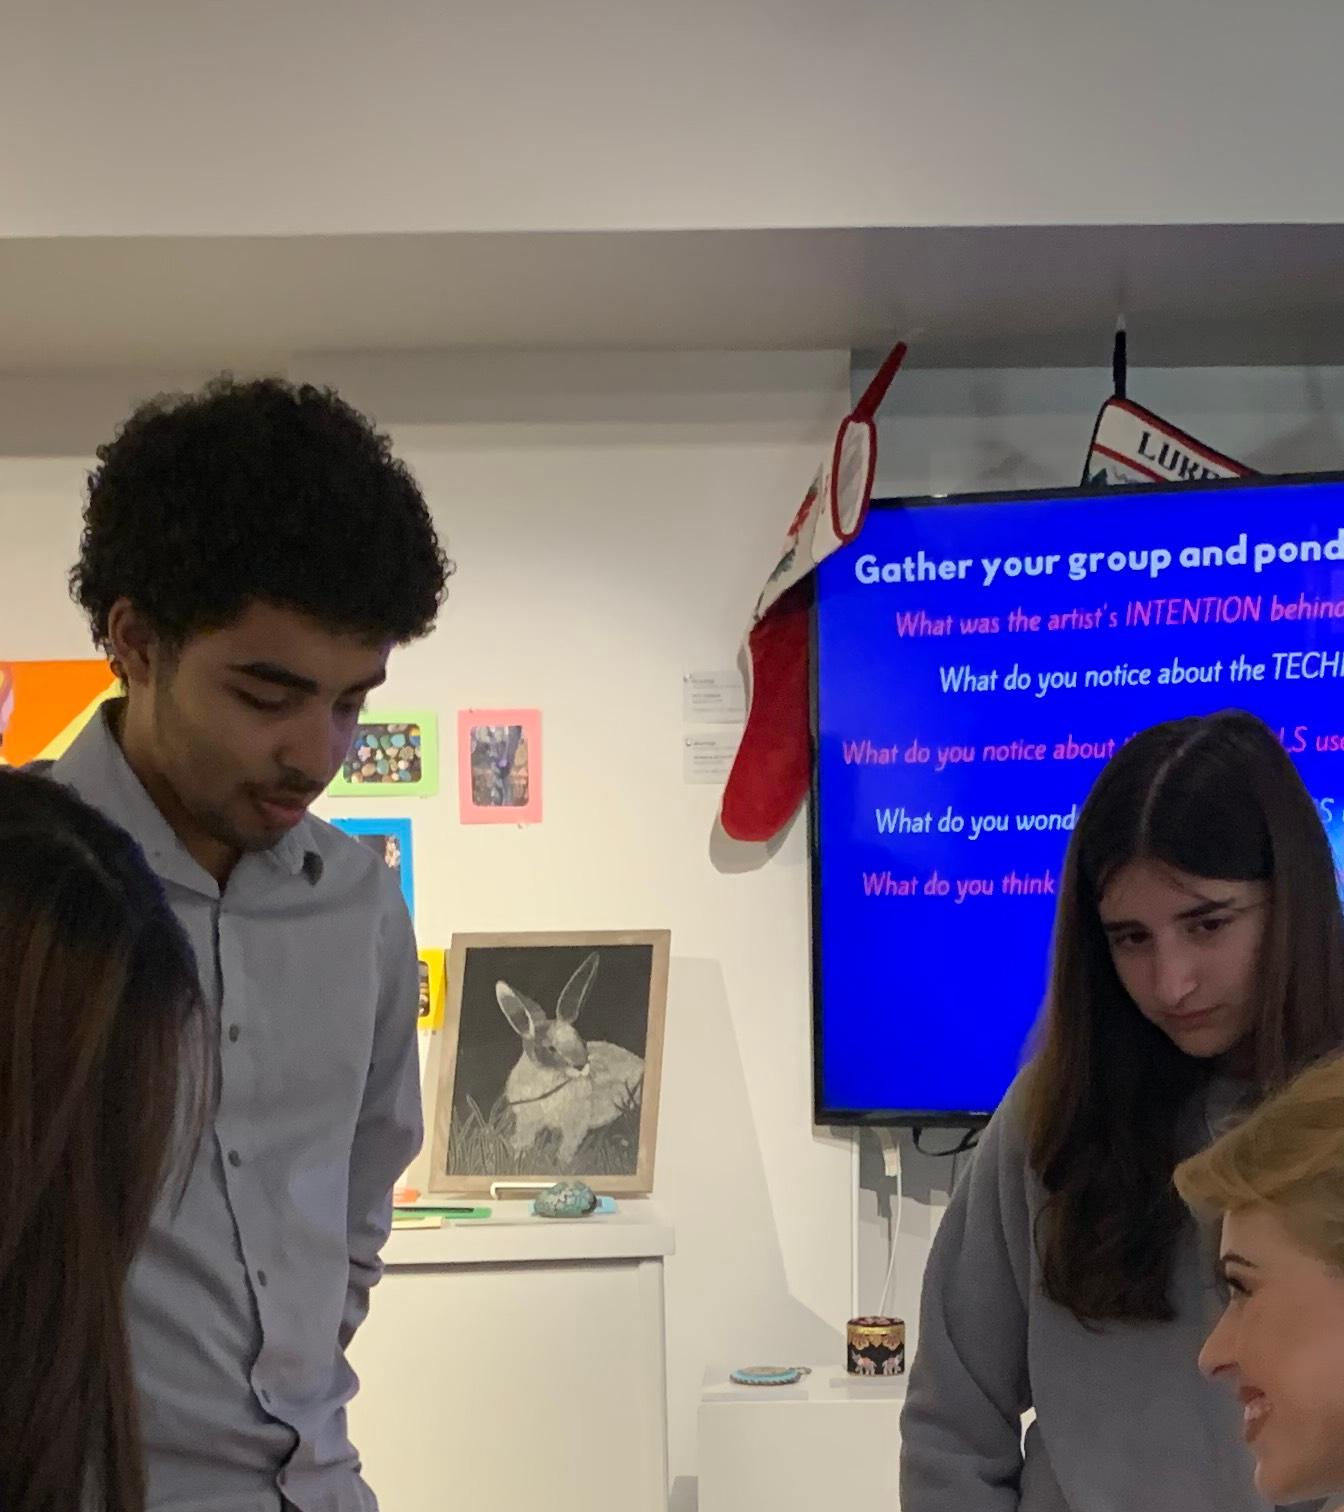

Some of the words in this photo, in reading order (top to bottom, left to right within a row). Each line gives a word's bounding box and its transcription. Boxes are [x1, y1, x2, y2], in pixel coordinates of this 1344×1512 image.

[855, 550, 973, 584] Gather
[981, 554, 1061, 587] your
[1068, 547, 1171, 581] group
[1179, 533, 1247, 568] and
[895, 611, 953, 638] What
[959, 615, 1000, 635] was
[1008, 606, 1041, 633] the
[1047, 602, 1118, 631] artist's
[1125, 595, 1262, 627] INTENTION
[939, 664, 998, 694] What
[1003, 663, 1032, 690] do
[1035, 671, 1077, 699] you
[1084, 663, 1152, 688] notice
[1157, 656, 1222, 684] about
[1229, 654, 1265, 681] the
[842, 739, 898, 765] What
[904, 738, 930, 763] do
[937, 745, 975, 772] you
[982, 738, 1046, 763] notice
[1052, 734, 1115, 761] about
[875, 807, 933, 835] What
[937, 806, 965, 833] do
[969, 814, 1009, 841] you
[1015, 804, 1078, 831] wond
[862, 871, 919, 897] What
[923, 870, 950, 896] do
[954, 878, 994, 905] you
[1002, 869, 1055, 896] think
